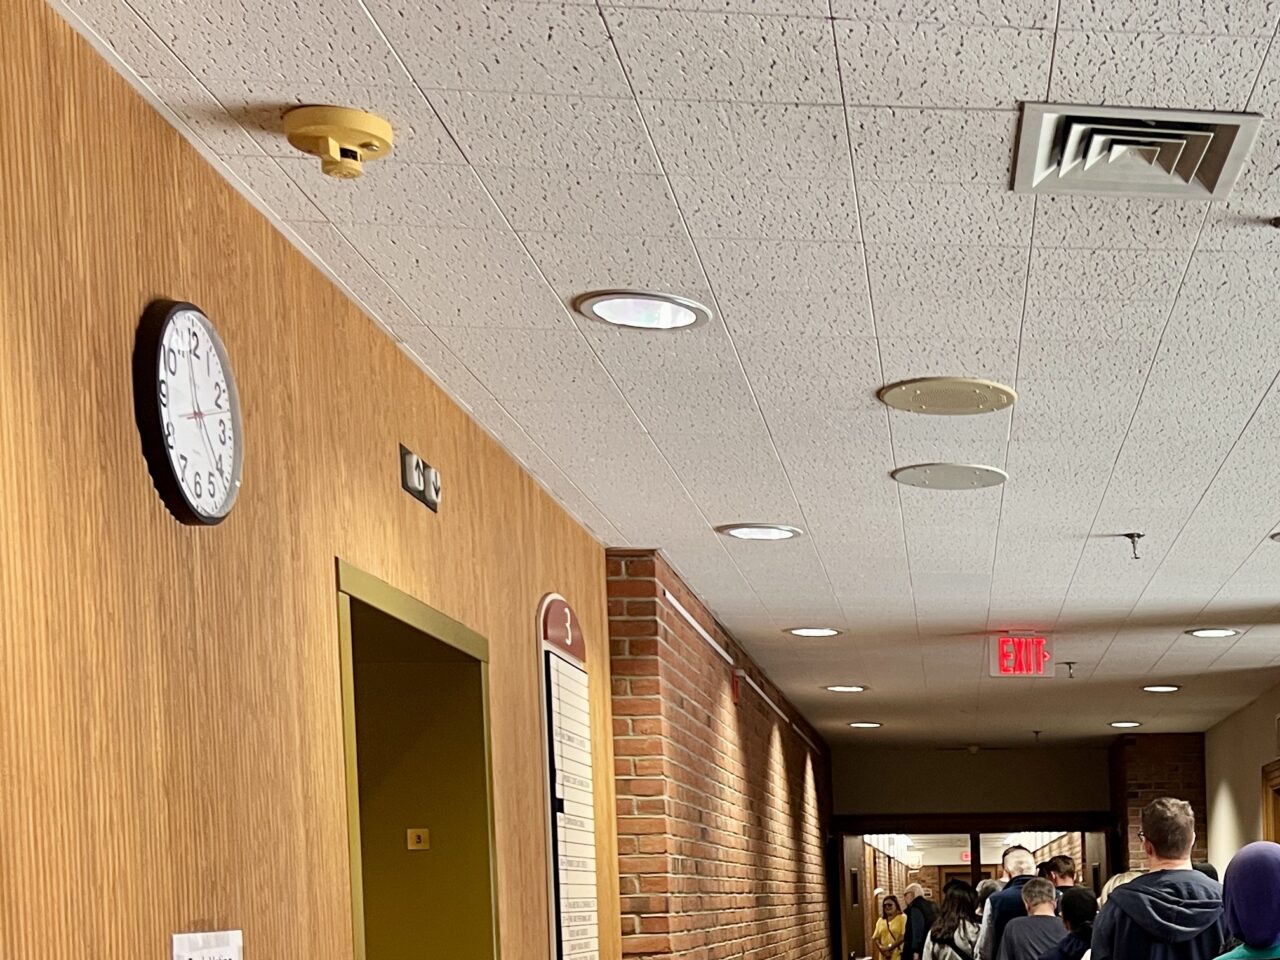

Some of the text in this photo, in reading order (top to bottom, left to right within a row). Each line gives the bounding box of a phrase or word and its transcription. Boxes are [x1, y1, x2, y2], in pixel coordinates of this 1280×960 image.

[187, 327, 201, 360] 12
[161, 343, 177, 376] 10
[205, 350, 210, 377] 1
[214, 381, 223, 410] 2
[218, 418, 226, 446] 3
[179, 453, 188, 483] 7
[215, 453, 225, 480] 4
[194, 471, 202, 499] 6
[207, 471, 216, 499] 5
[564, 607, 572, 646] 3
[998, 637, 1046, 675] EXIT
